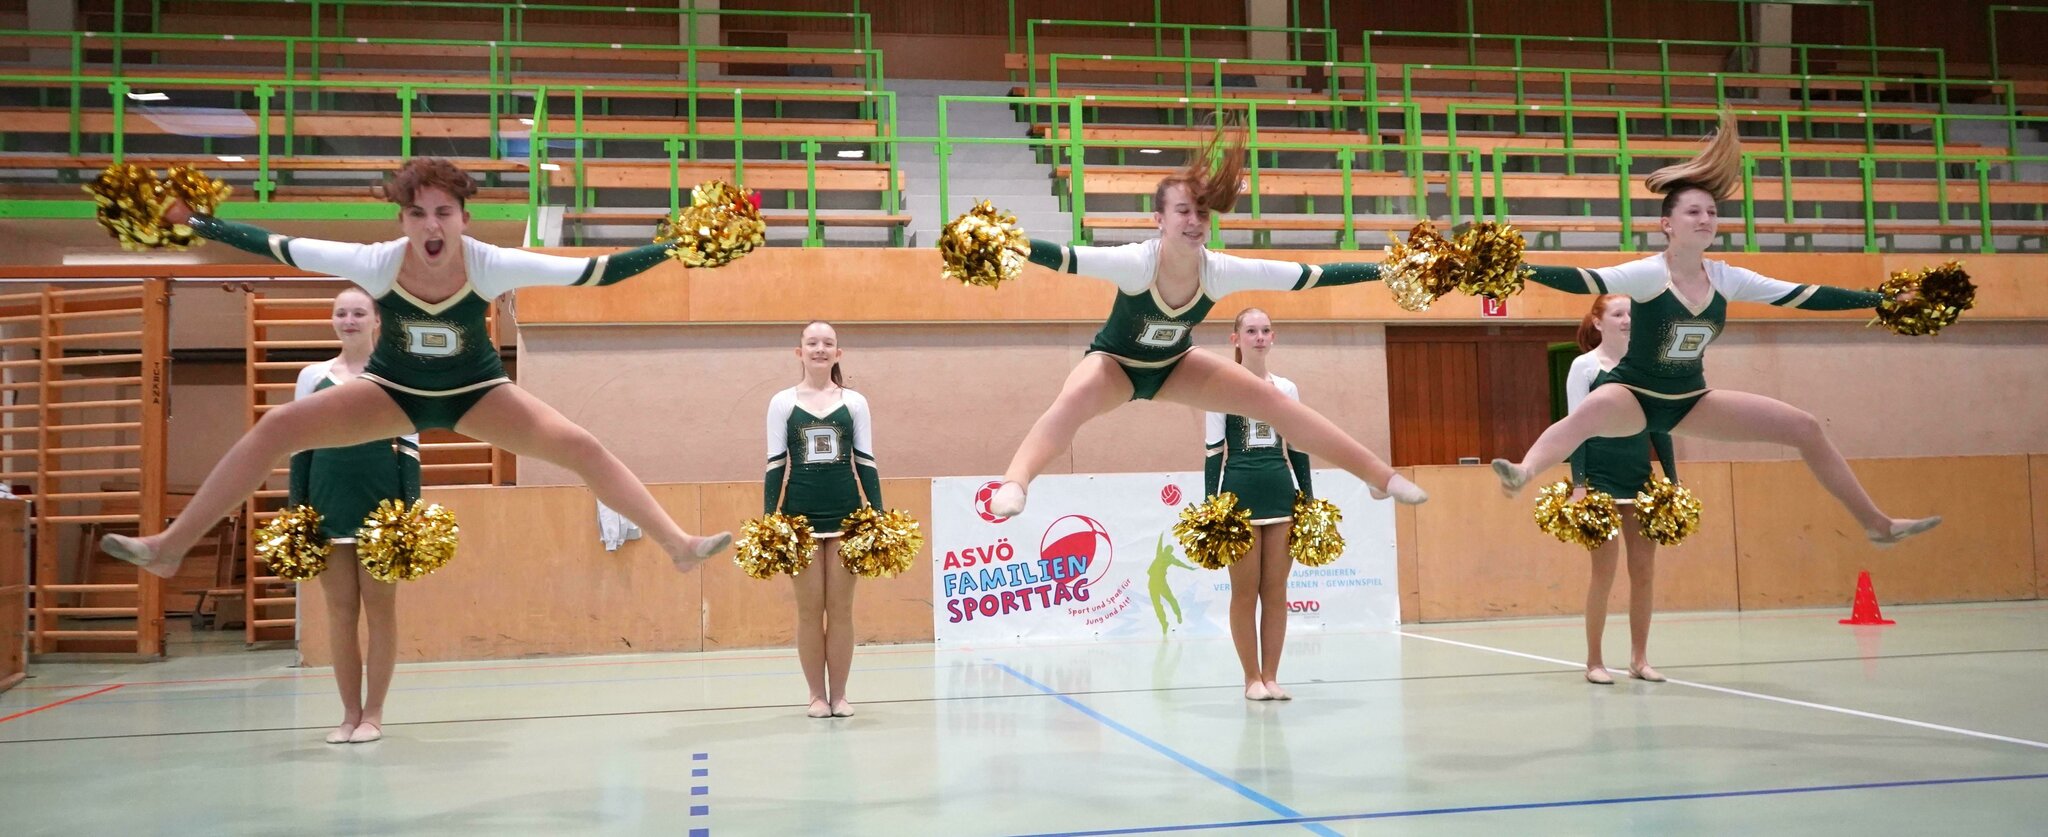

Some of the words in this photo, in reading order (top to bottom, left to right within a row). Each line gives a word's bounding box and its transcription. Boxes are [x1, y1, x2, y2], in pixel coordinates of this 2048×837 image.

[404, 322, 463, 357] D
[1136, 320, 1189, 347] D
[1663, 322, 1717, 360] D
[801, 424, 840, 464] D
[943, 538, 1014, 571] ASVÖ
[944, 554, 1087, 597] FAMILIEN
[1292, 568, 1357, 578] AUSPROBIEREN
[1326, 577, 1383, 588] GEWINNSPIEL
[947, 578, 1090, 623] SPORTTAG
[1068, 605, 1090, 616] Sport
[1092, 601, 1106, 612] und
[1106, 588, 1123, 604] Spaß
[1121, 578, 1131, 590] für
[1086, 617, 1104, 625] Jung
[1105, 608, 1119, 619] und
[1119, 596, 1131, 611] Alt!
